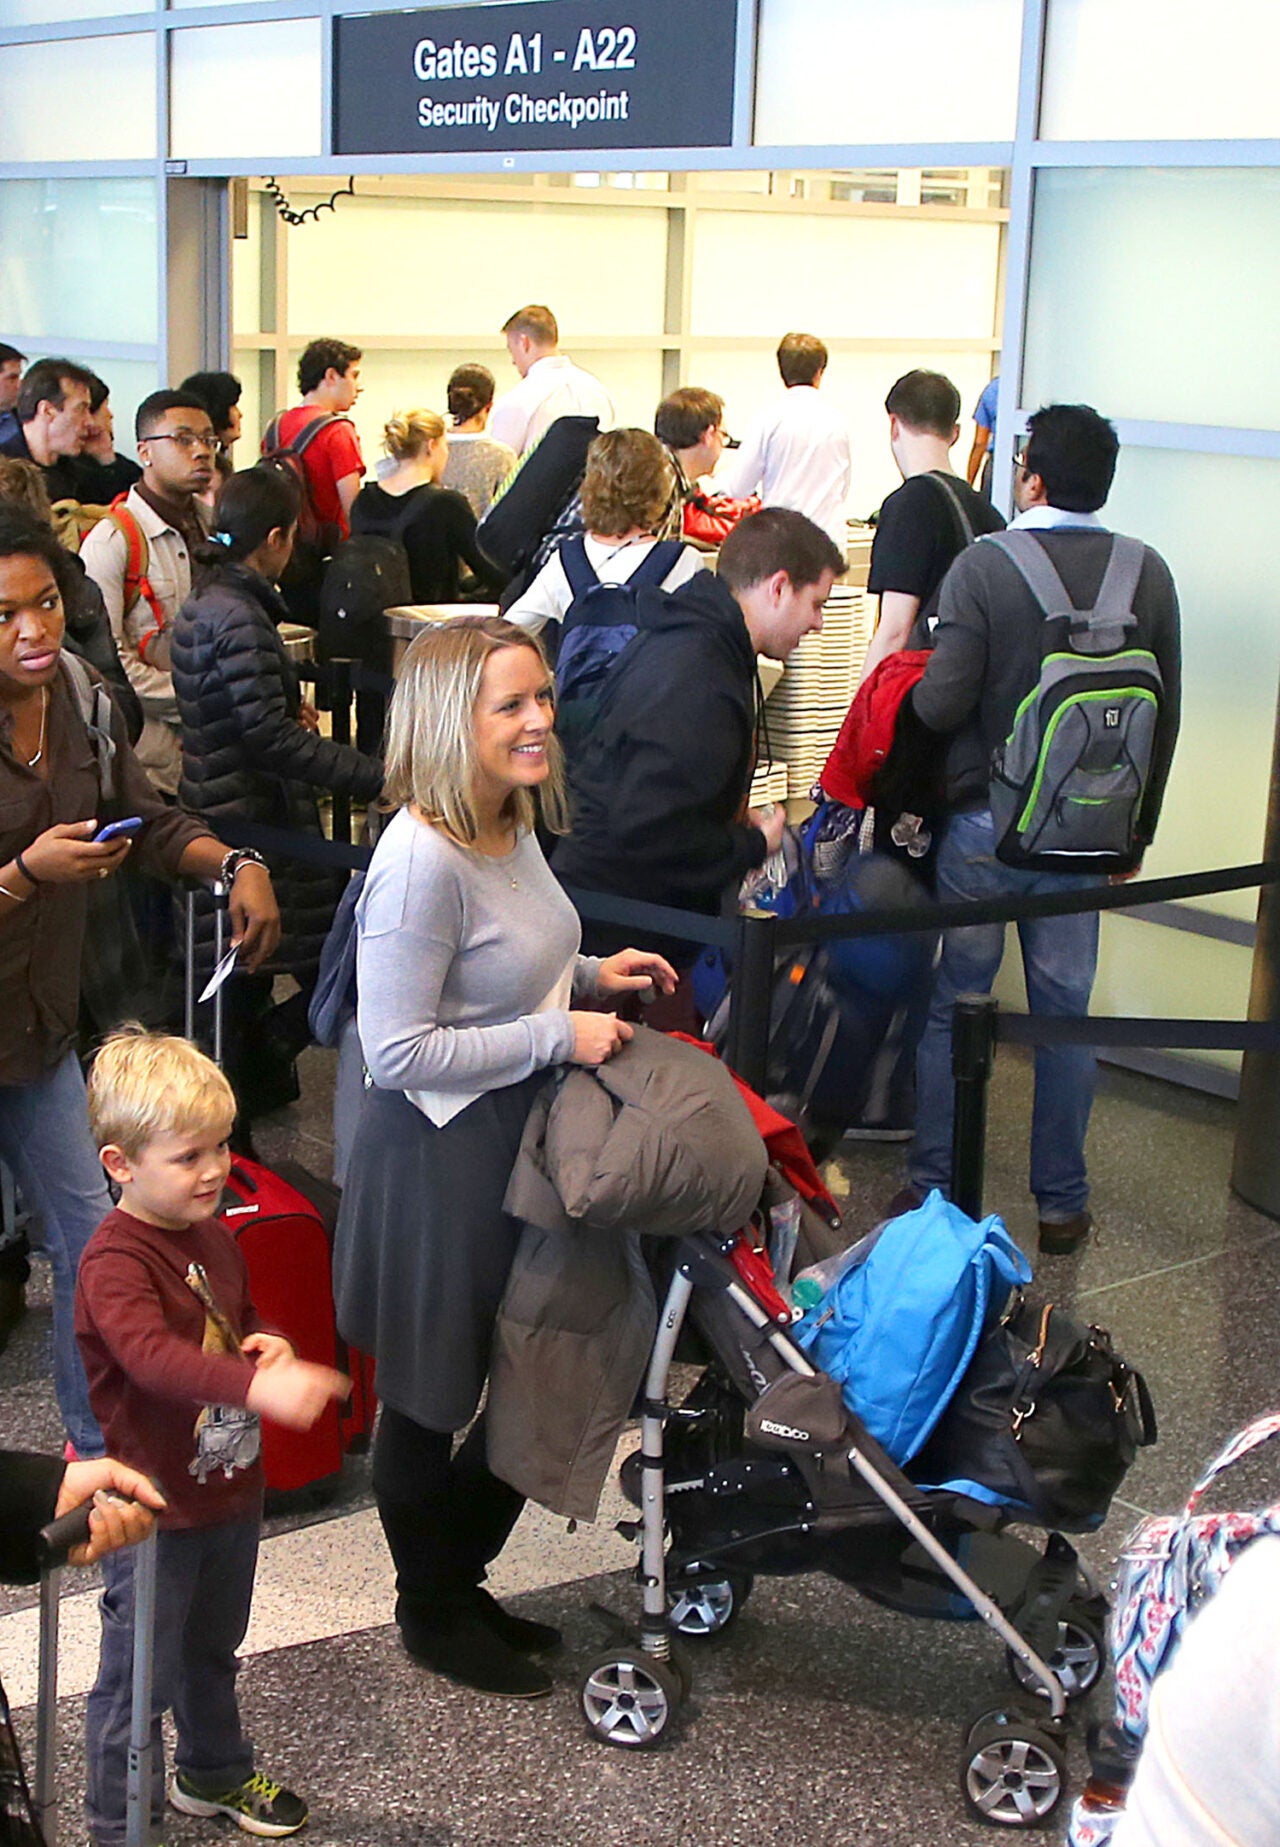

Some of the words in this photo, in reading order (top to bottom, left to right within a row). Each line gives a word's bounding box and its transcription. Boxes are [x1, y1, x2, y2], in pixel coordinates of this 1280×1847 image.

[414, 38, 498, 81] Gates
[504, 32, 542, 75] A1
[552, 50, 566, 62] -
[572, 26, 637, 72] A22
[418, 96, 501, 132] Security
[505, 89, 629, 129] Checkpoint
